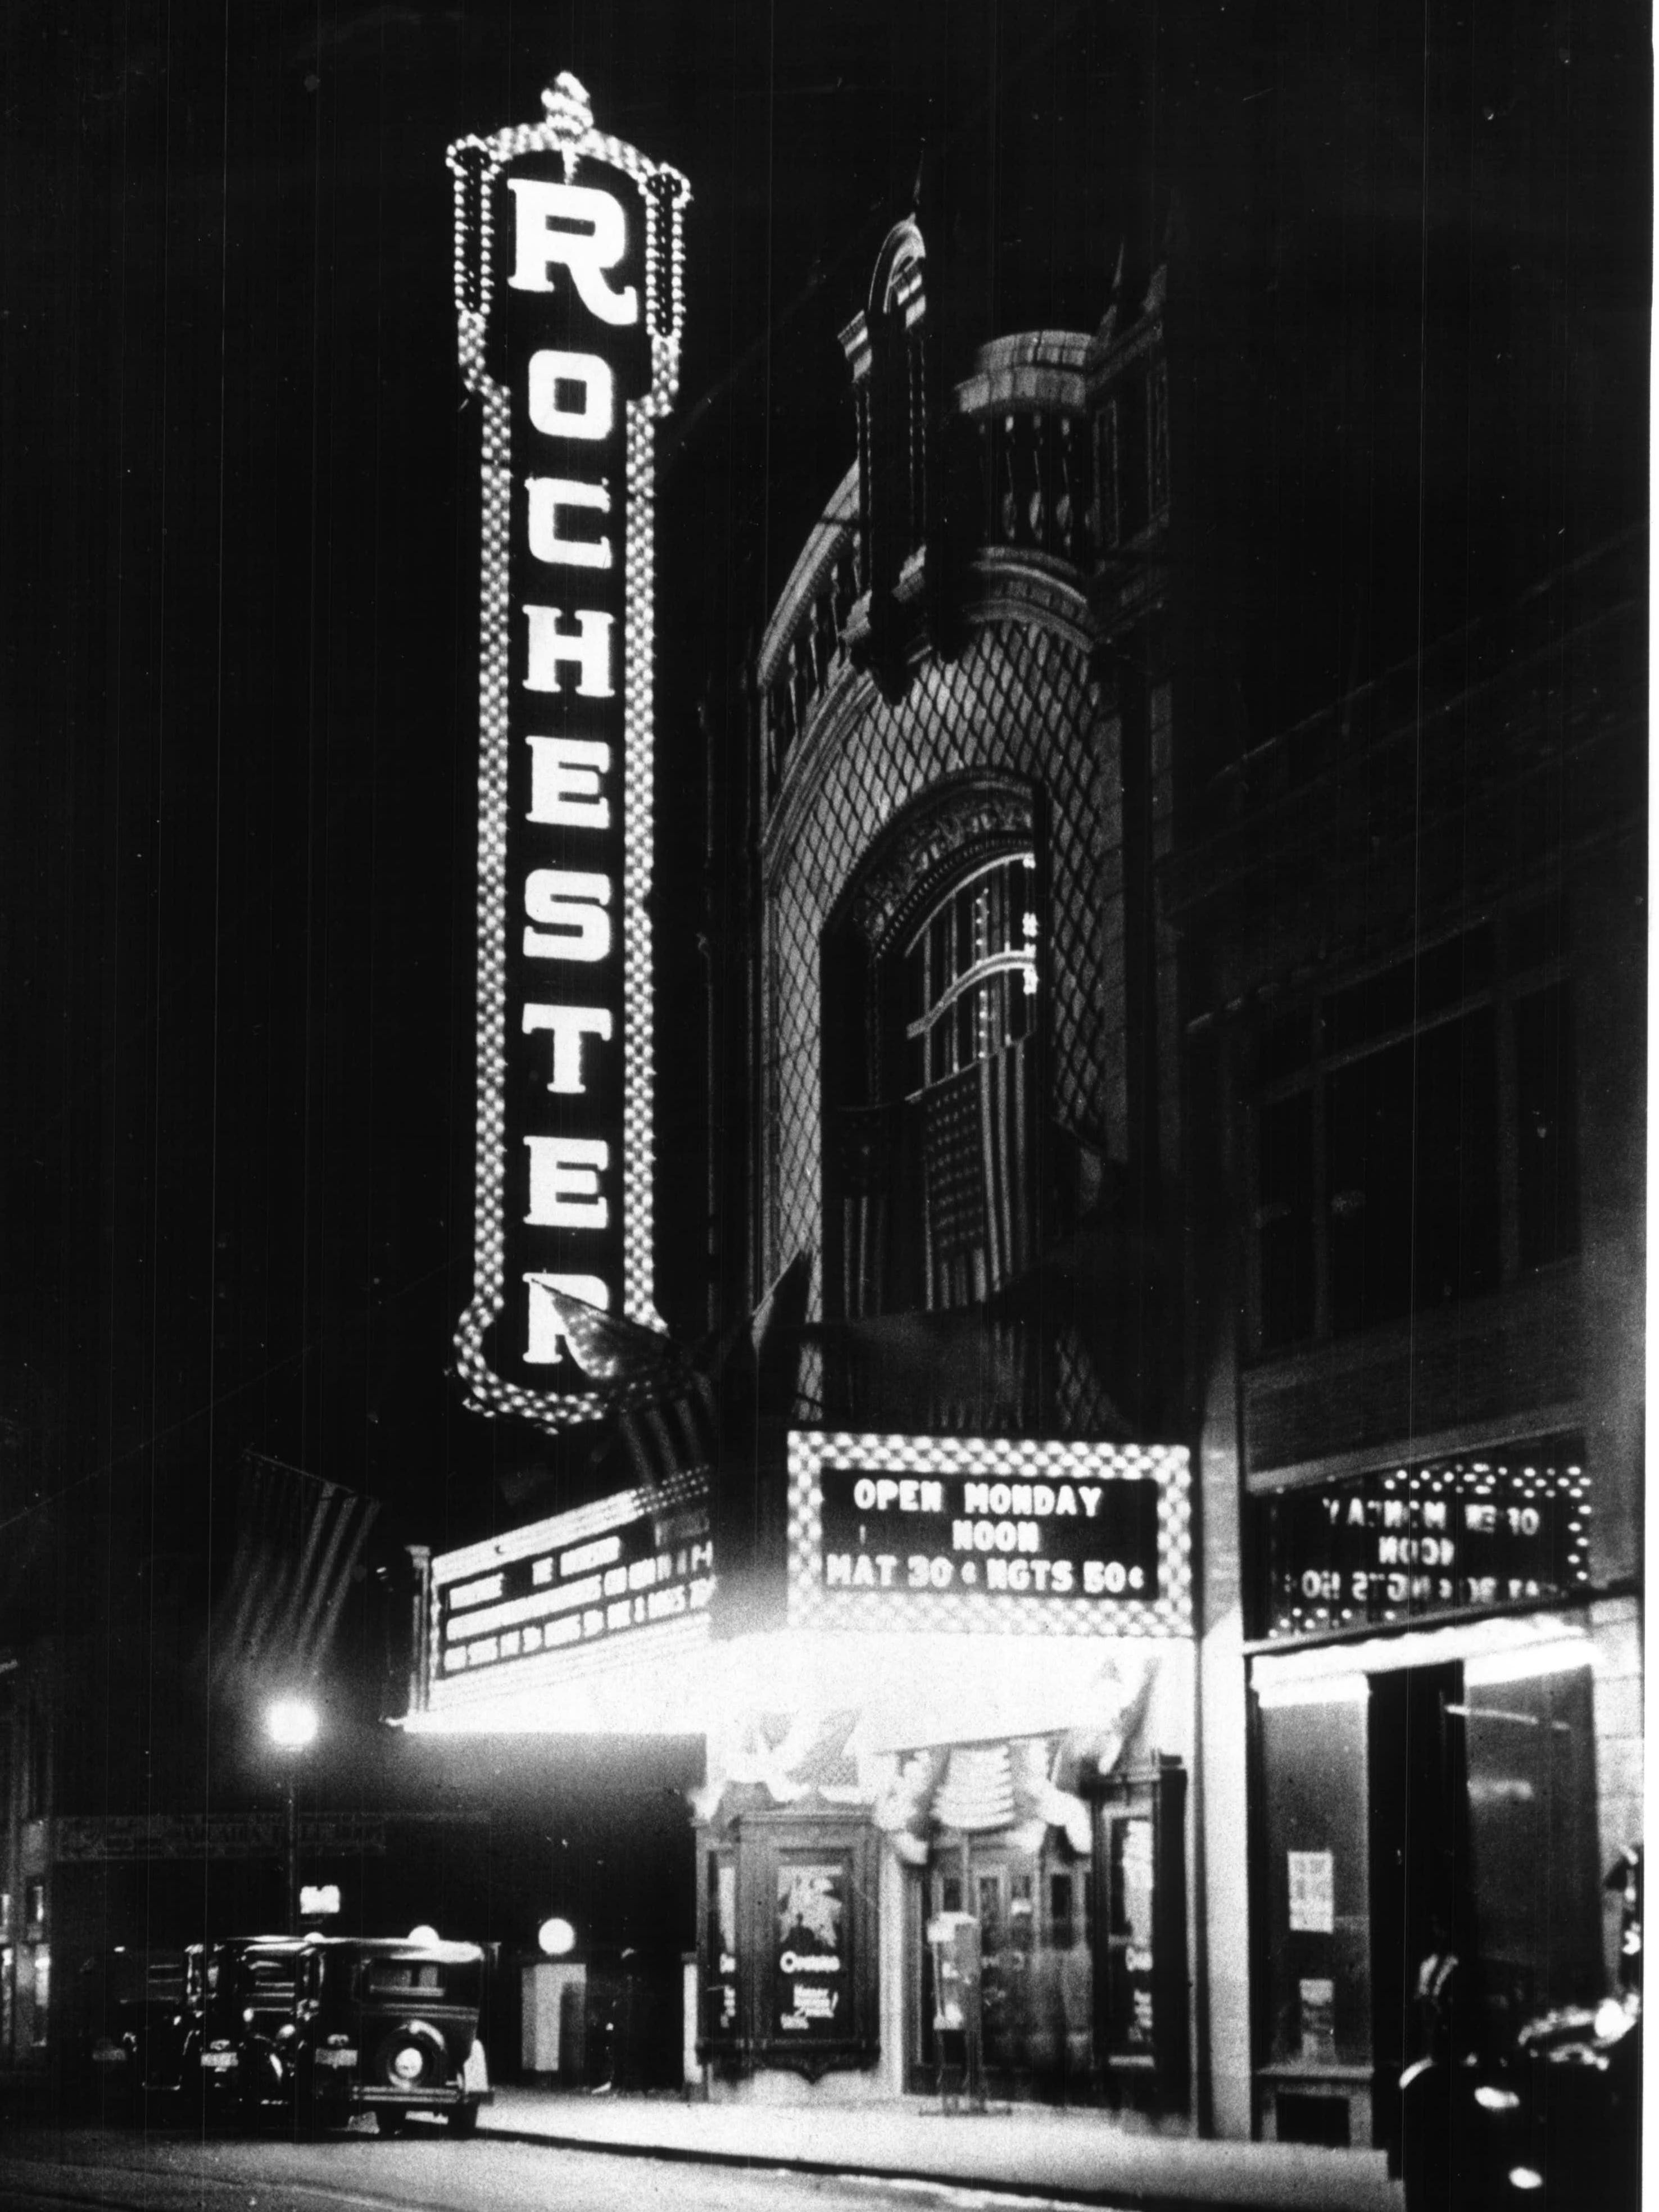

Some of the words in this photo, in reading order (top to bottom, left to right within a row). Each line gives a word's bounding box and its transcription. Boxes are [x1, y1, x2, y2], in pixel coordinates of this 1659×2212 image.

[507, 175, 638, 1365] ROCHESTER
[853, 1478, 944, 1512] OPEN
[963, 1481, 1103, 1517] MONDAY
[951, 1519, 1040, 1553] NOON
[826, 1554, 899, 1587] MAT
[986, 1558, 1074, 1592] NGTS
